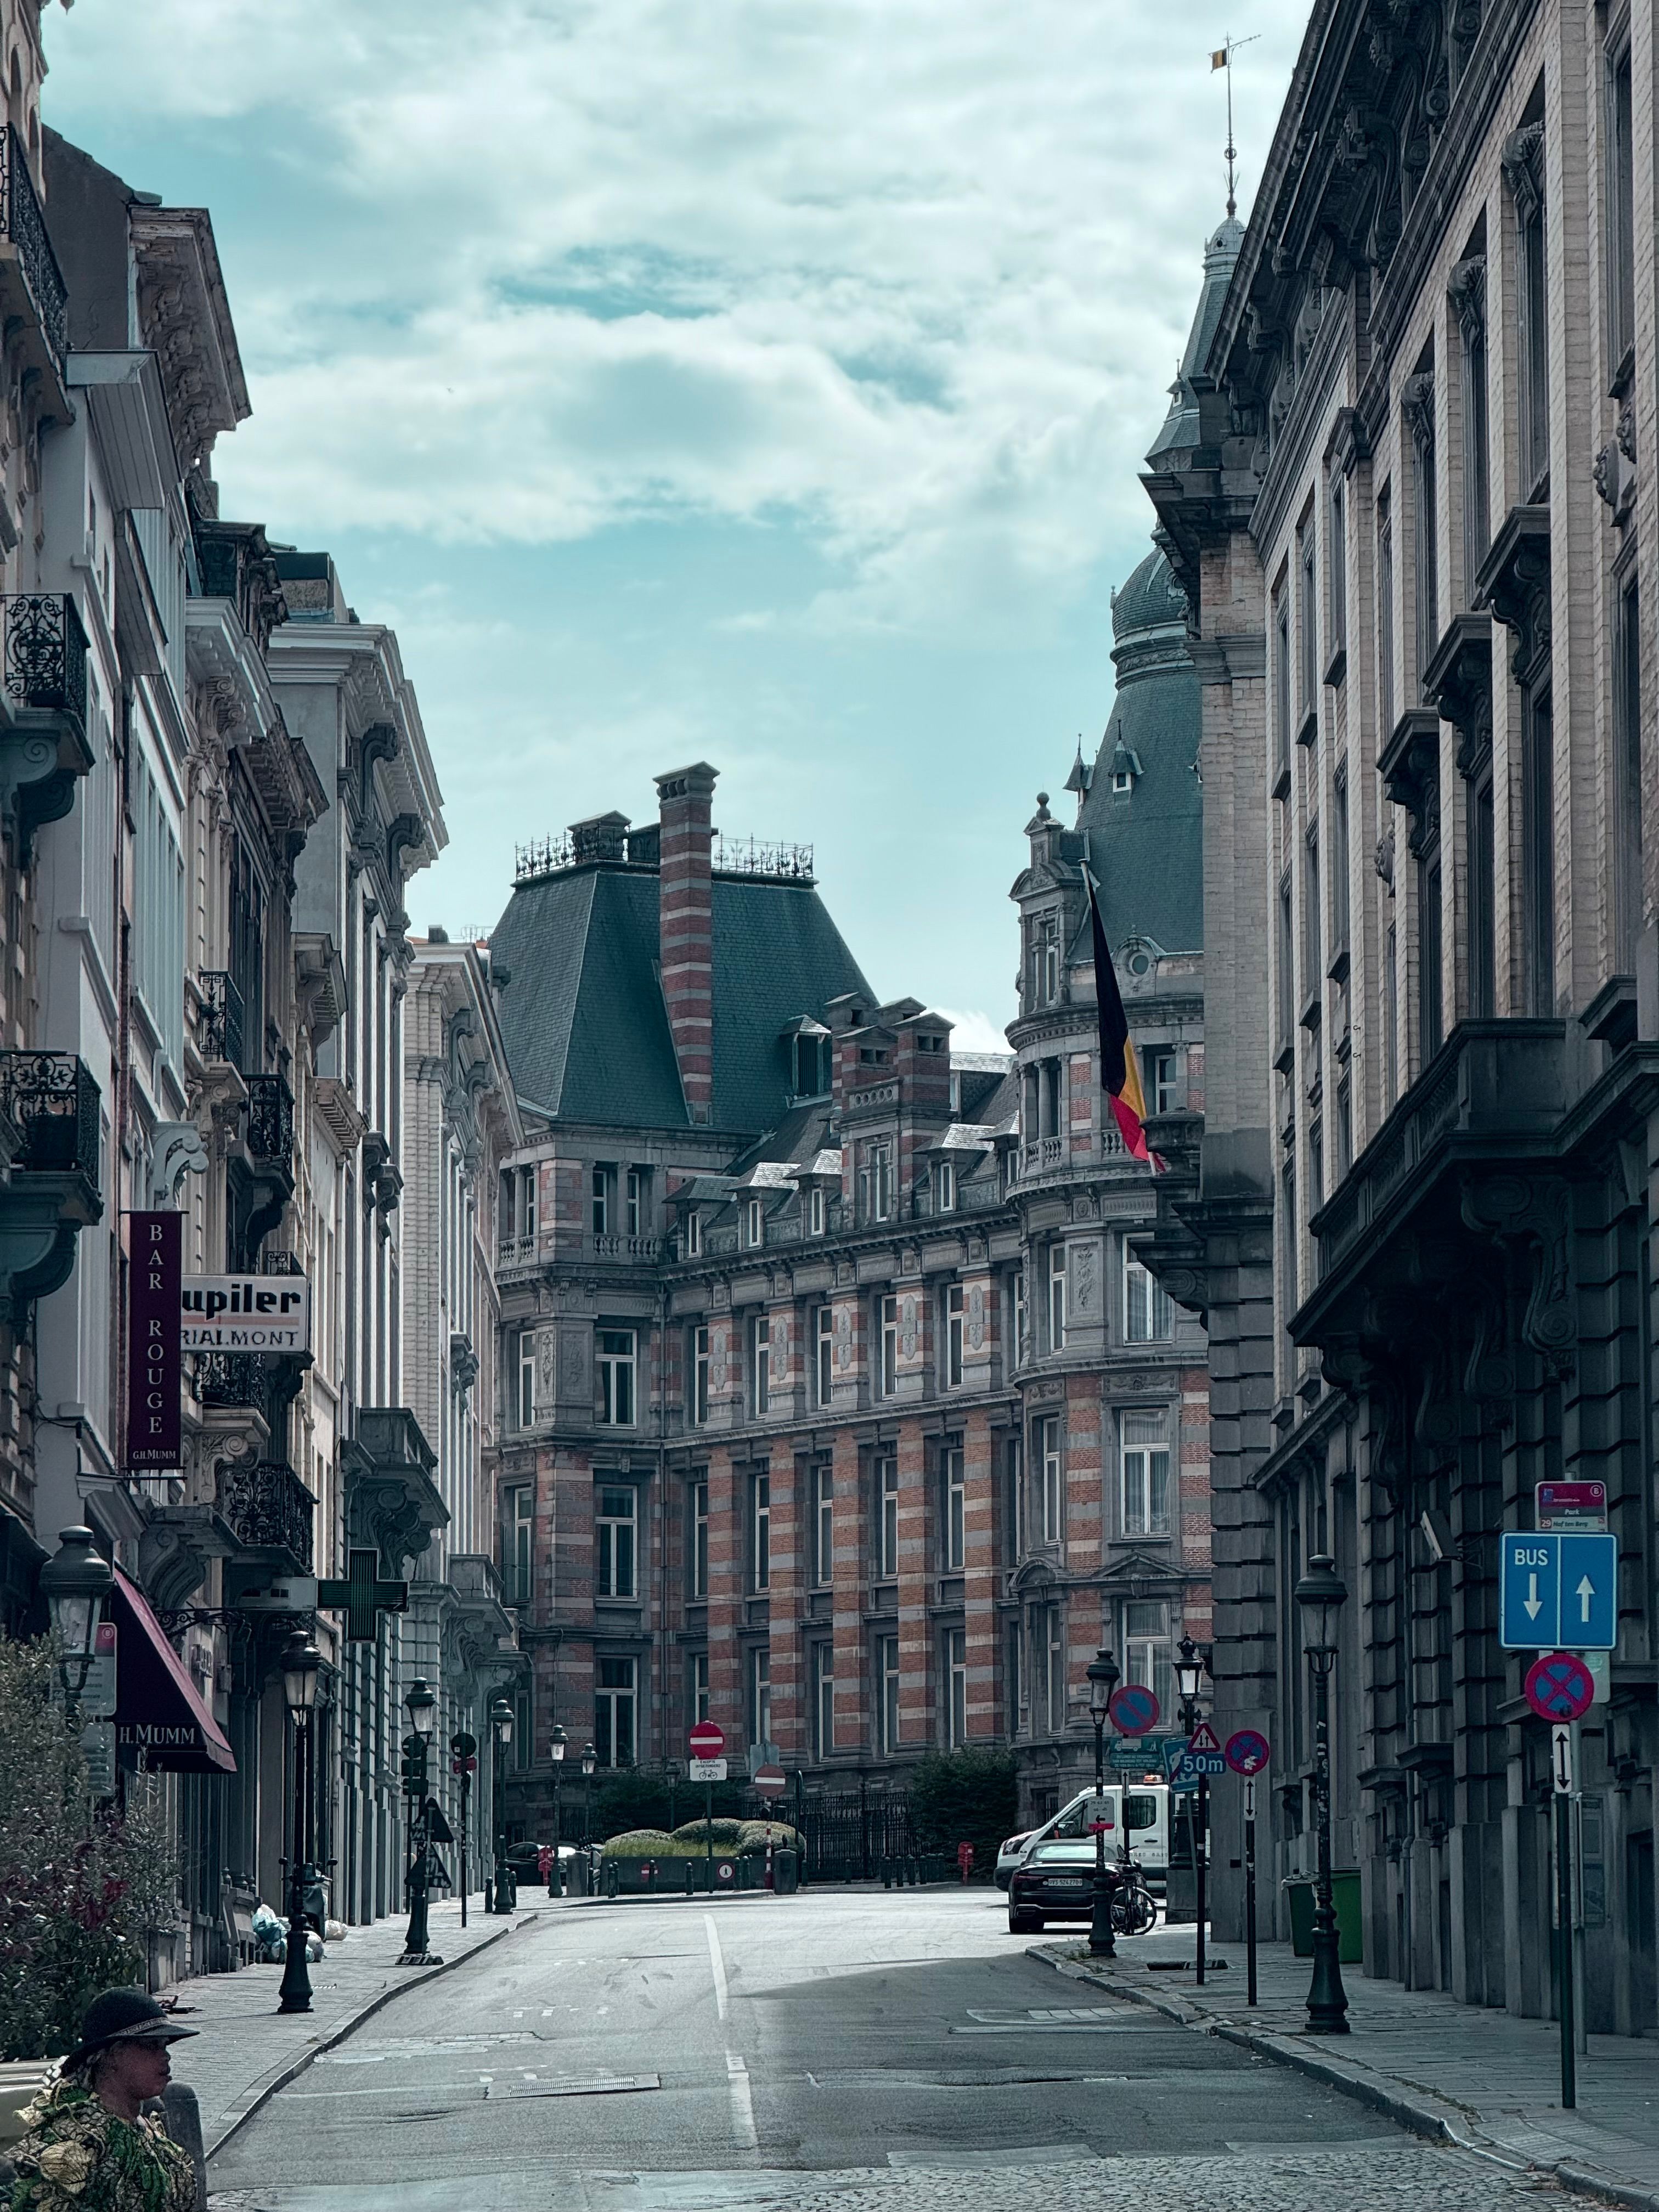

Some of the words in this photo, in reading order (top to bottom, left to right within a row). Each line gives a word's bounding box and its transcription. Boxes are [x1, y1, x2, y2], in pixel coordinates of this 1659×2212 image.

[148, 1224, 164, 1289] BAR
[146, 1320, 165, 1433] ROUGE
[1541, 1520, 1551, 1528] 29
[1514, 1549, 1548, 1566] BUS
[1183, 1756, 1223, 1772] 50m
